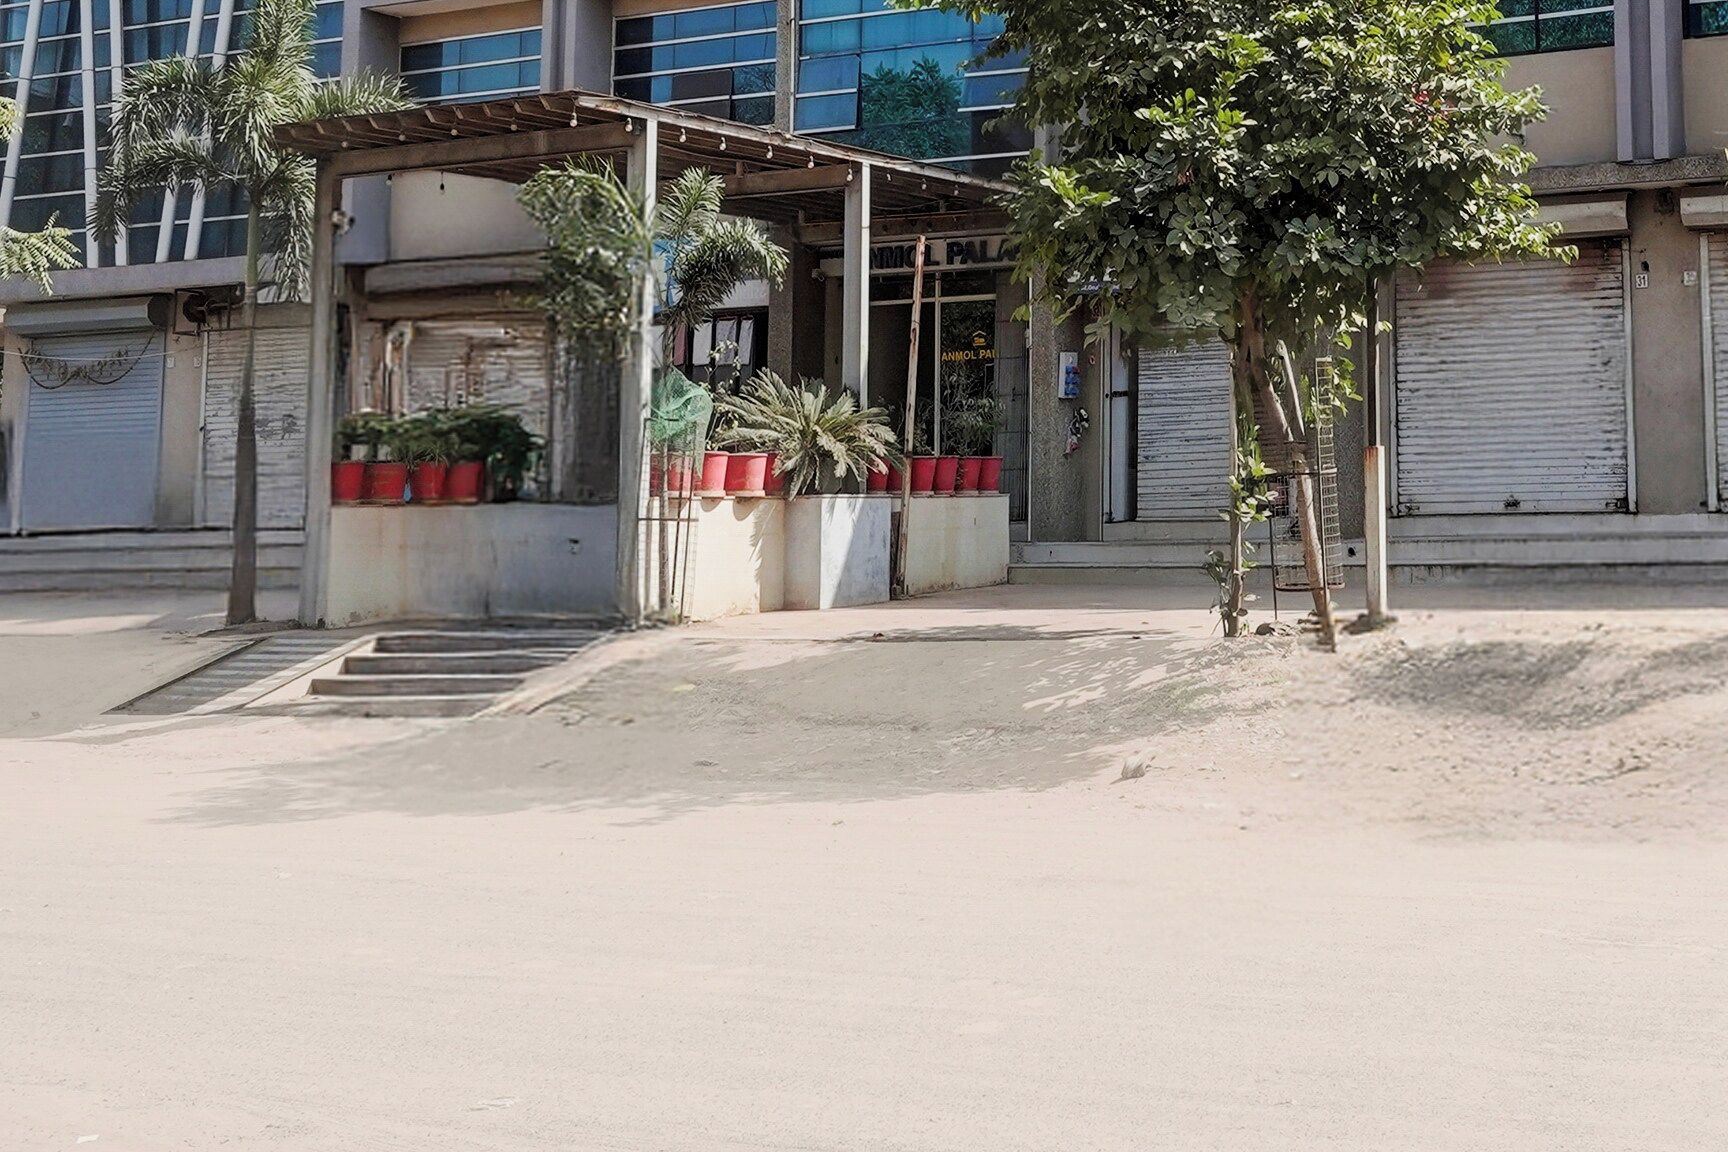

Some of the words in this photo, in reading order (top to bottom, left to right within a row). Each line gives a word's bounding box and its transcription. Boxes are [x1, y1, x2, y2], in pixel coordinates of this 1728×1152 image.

[870, 243, 940, 269] NMOL
[946, 238, 1022, 265] PALA
[1637, 275, 1647, 287] 31
[941, 350, 977, 361] ANMOL
[979, 348, 997, 359] PAL
